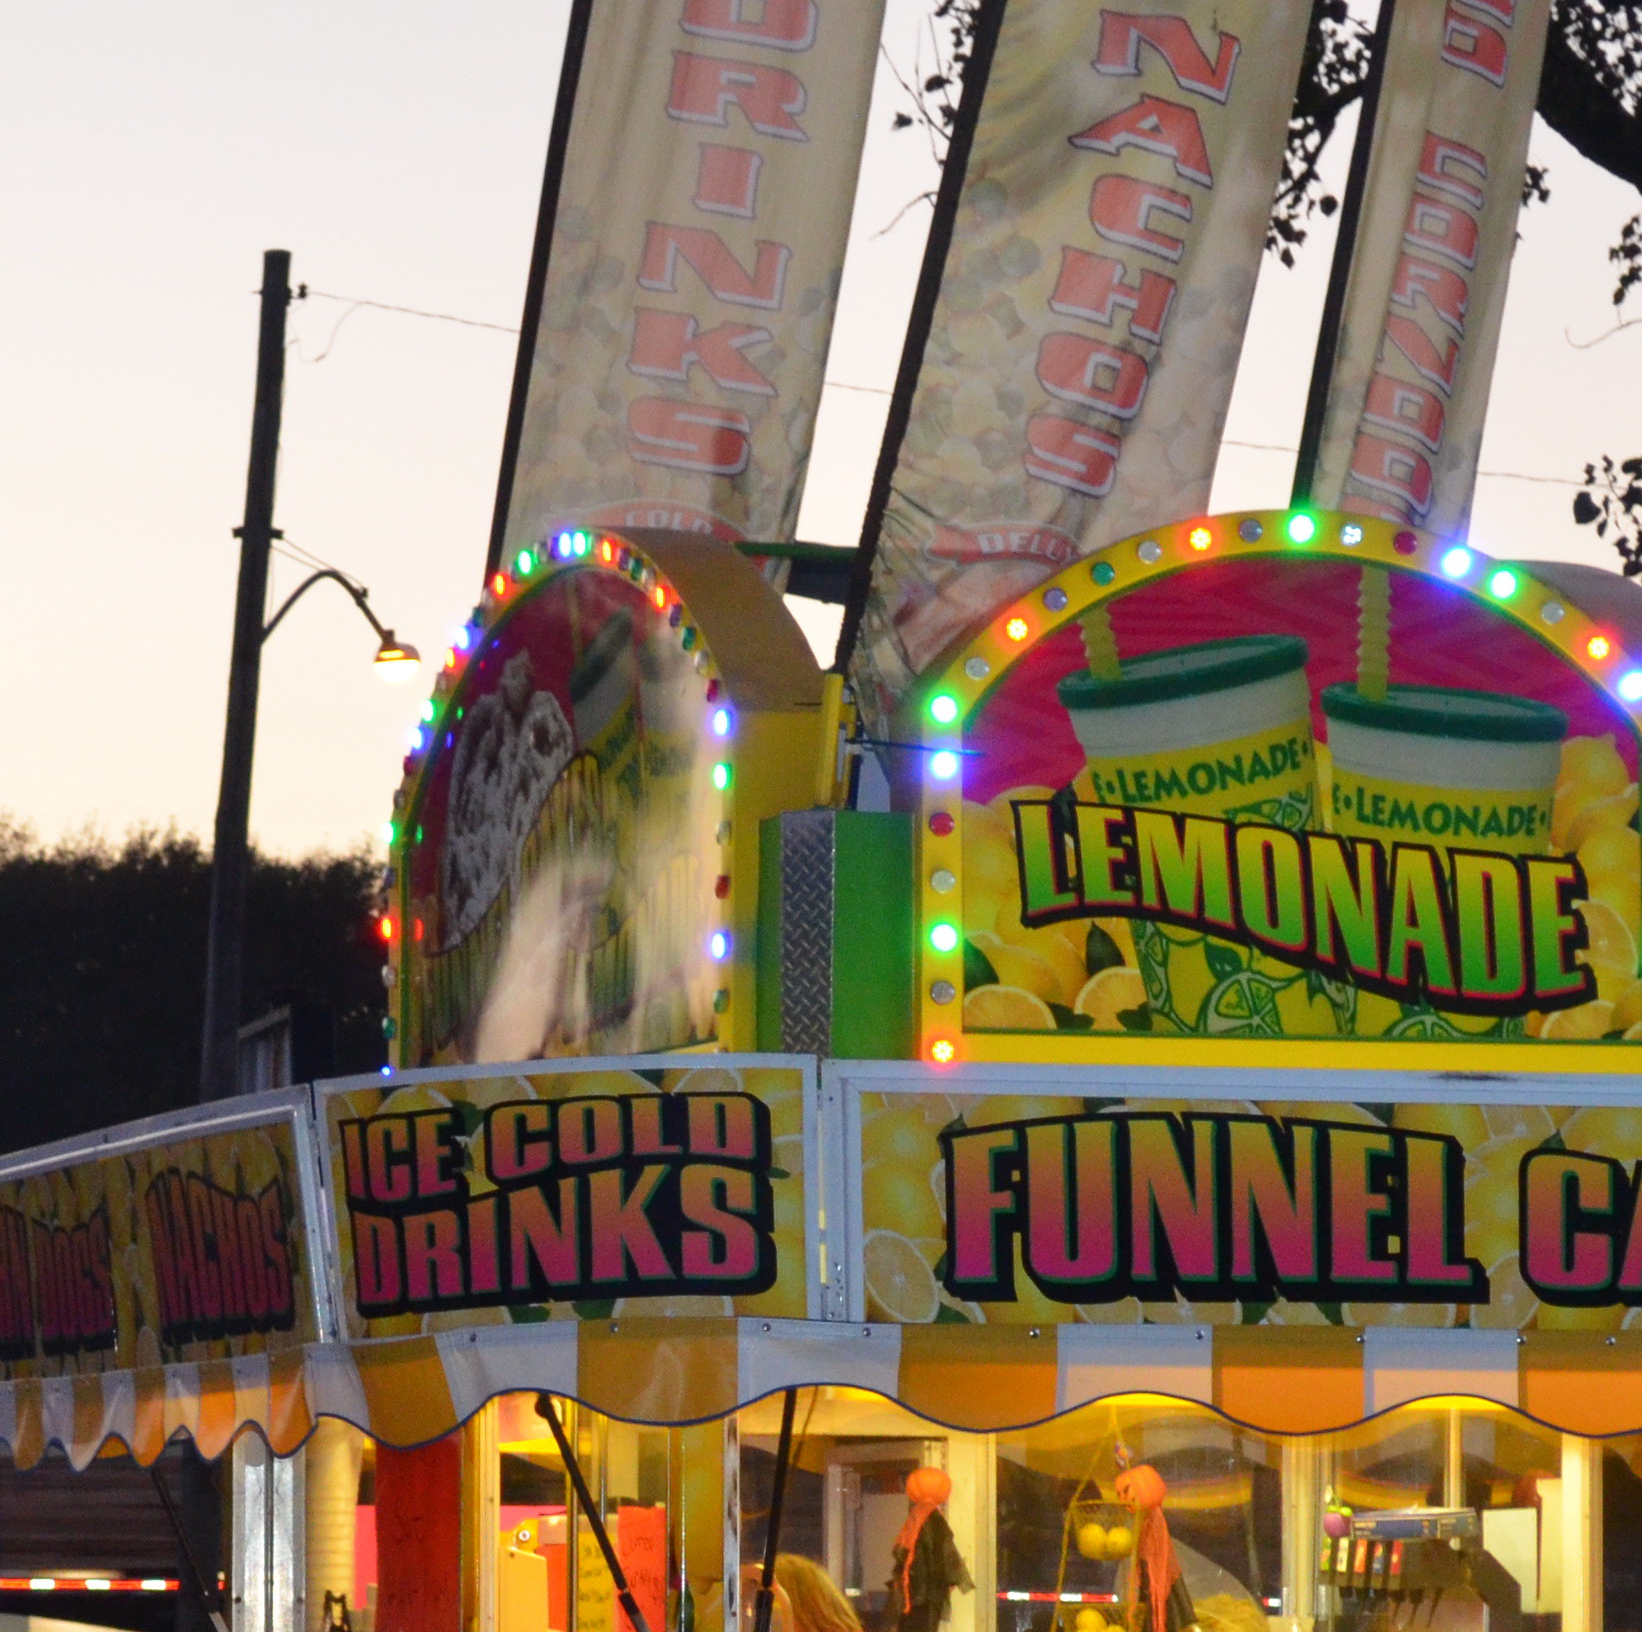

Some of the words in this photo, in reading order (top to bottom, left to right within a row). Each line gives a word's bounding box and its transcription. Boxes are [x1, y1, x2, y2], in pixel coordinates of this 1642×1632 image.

[1023, 8, 1241, 498] NACHOS
[1340, 129, 1488, 528] CORNDO
[1116, 735, 1299, 804] LEMONADE
[1355, 792, 1537, 839] LEMONADE
[1011, 800, 1600, 1016] LEMONADE
[340, 1105, 467, 1203] ICE
[484, 1091, 773, 1191] COLD
[937, 1110, 1490, 1304] FUNNEL
[352, 1164, 777, 1318] DRINKS
